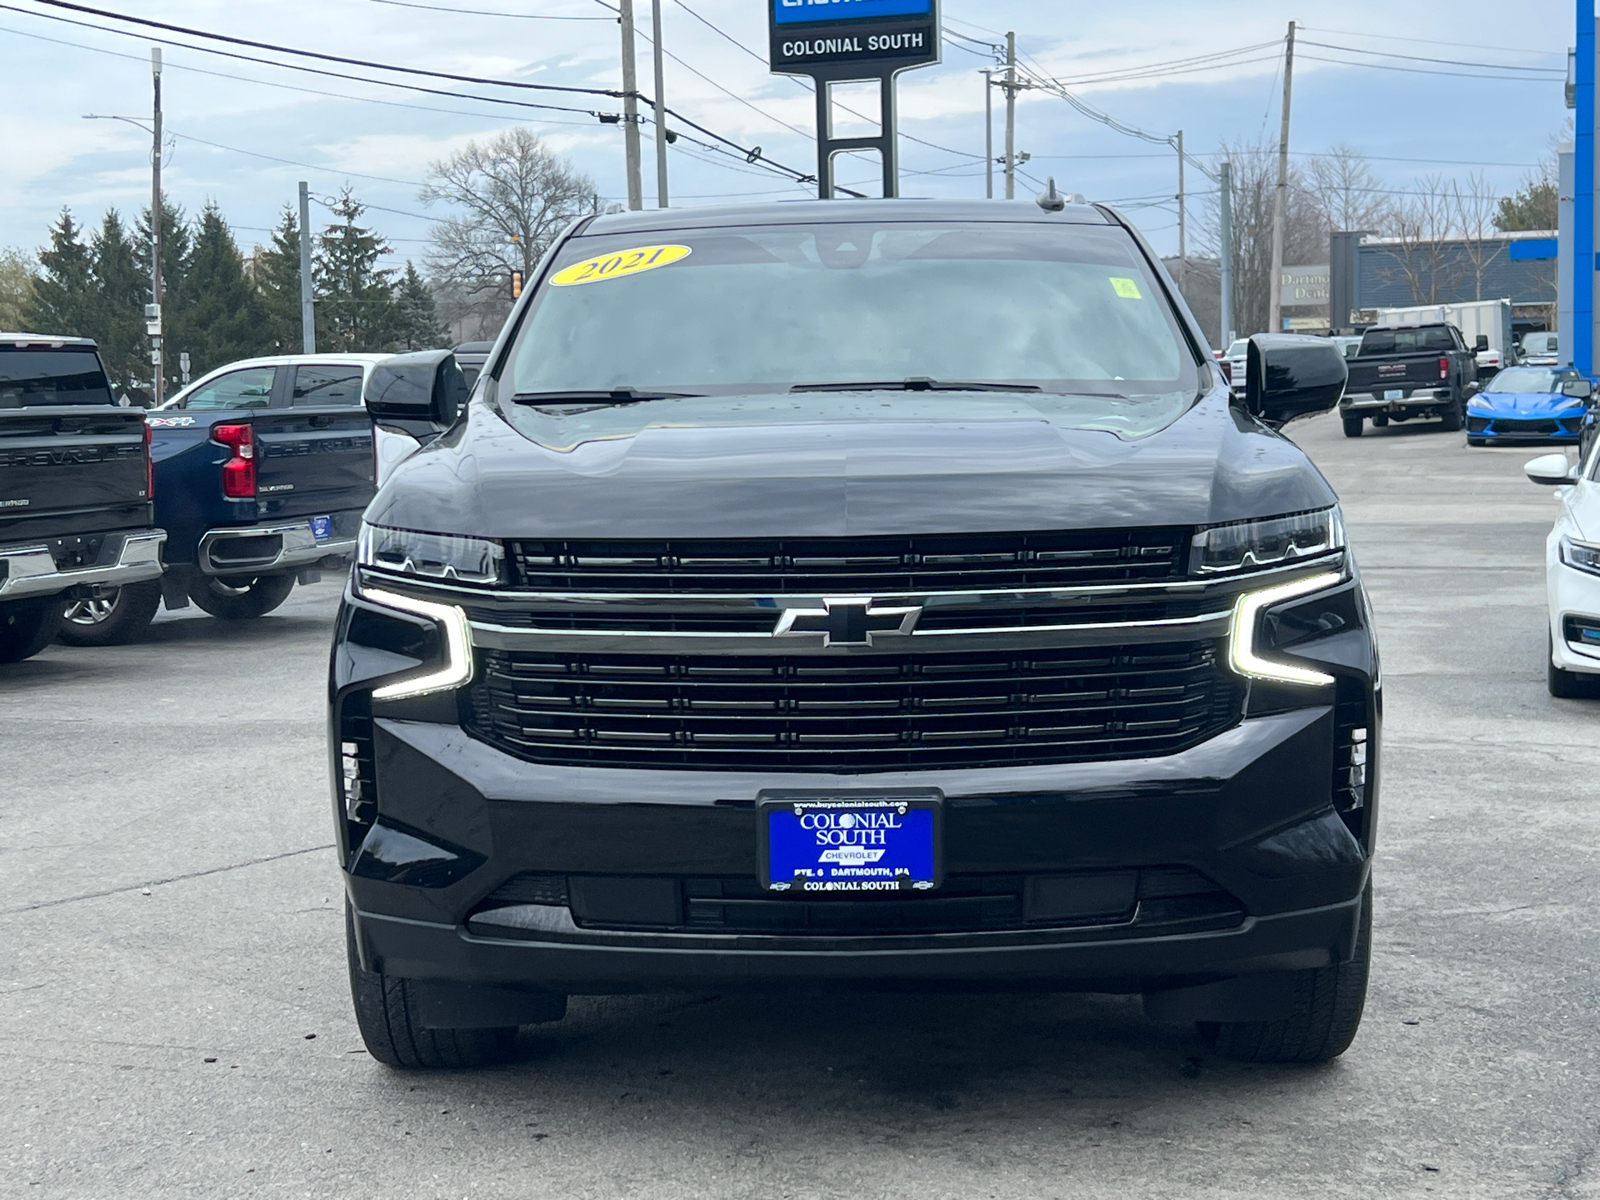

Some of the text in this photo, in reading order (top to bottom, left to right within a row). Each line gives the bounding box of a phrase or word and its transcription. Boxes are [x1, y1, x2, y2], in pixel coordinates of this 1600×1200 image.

[782, 33, 923, 57] COLONIAL SOUTH
[574, 248, 665, 281] 2021
[1281, 274, 1330, 285] Dartmo
[800, 812, 902, 830] COLONIAL
[816, 829, 886, 846] SOUTH
[825, 851, 878, 860] CHEVROLET
[831, 868, 893, 877] DARTMOUTH,
[803, 881, 900, 891] COLONIAL SOUTH
